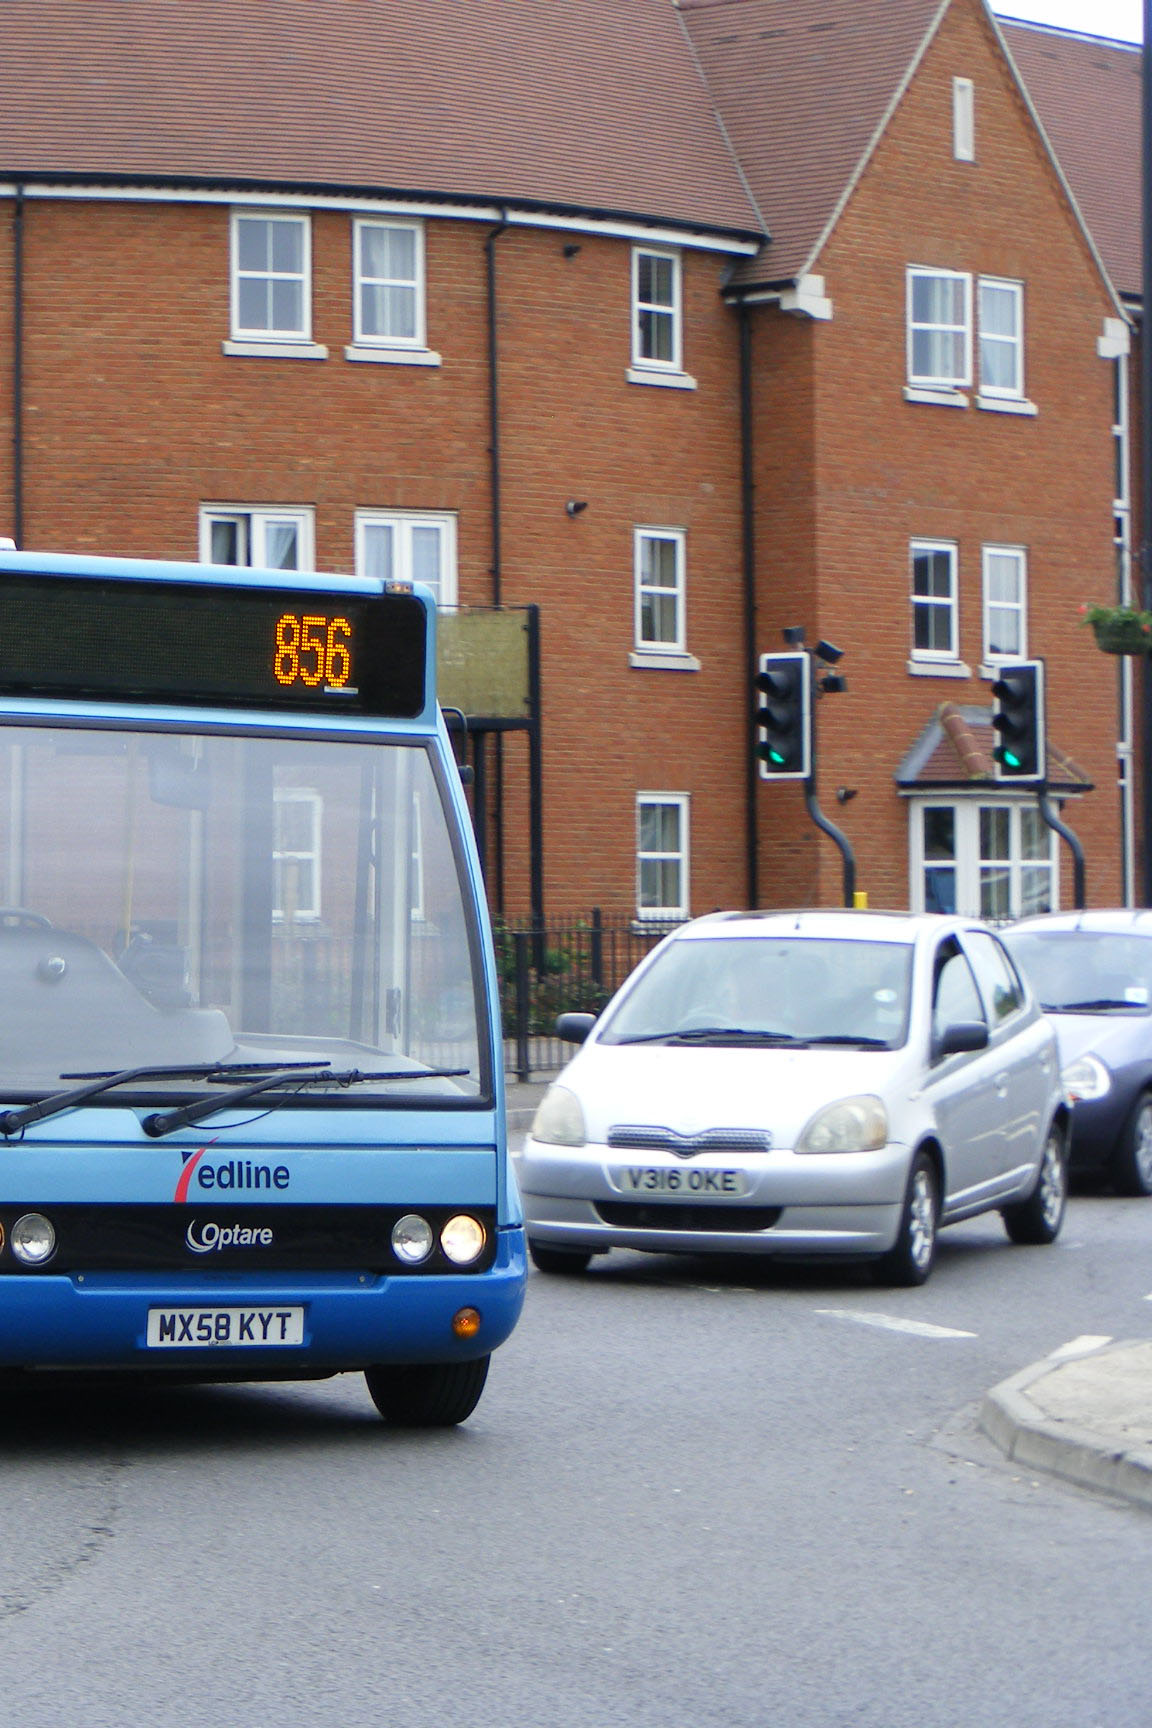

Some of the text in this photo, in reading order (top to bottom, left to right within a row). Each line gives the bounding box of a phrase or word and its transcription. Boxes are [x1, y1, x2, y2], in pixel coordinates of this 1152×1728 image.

[274, 614, 351, 687] 856
[628, 1167, 737, 1192] V316 OKE
[199, 1221, 273, 1250] Optare
[159, 1312, 292, 1342] MX58 KYT
